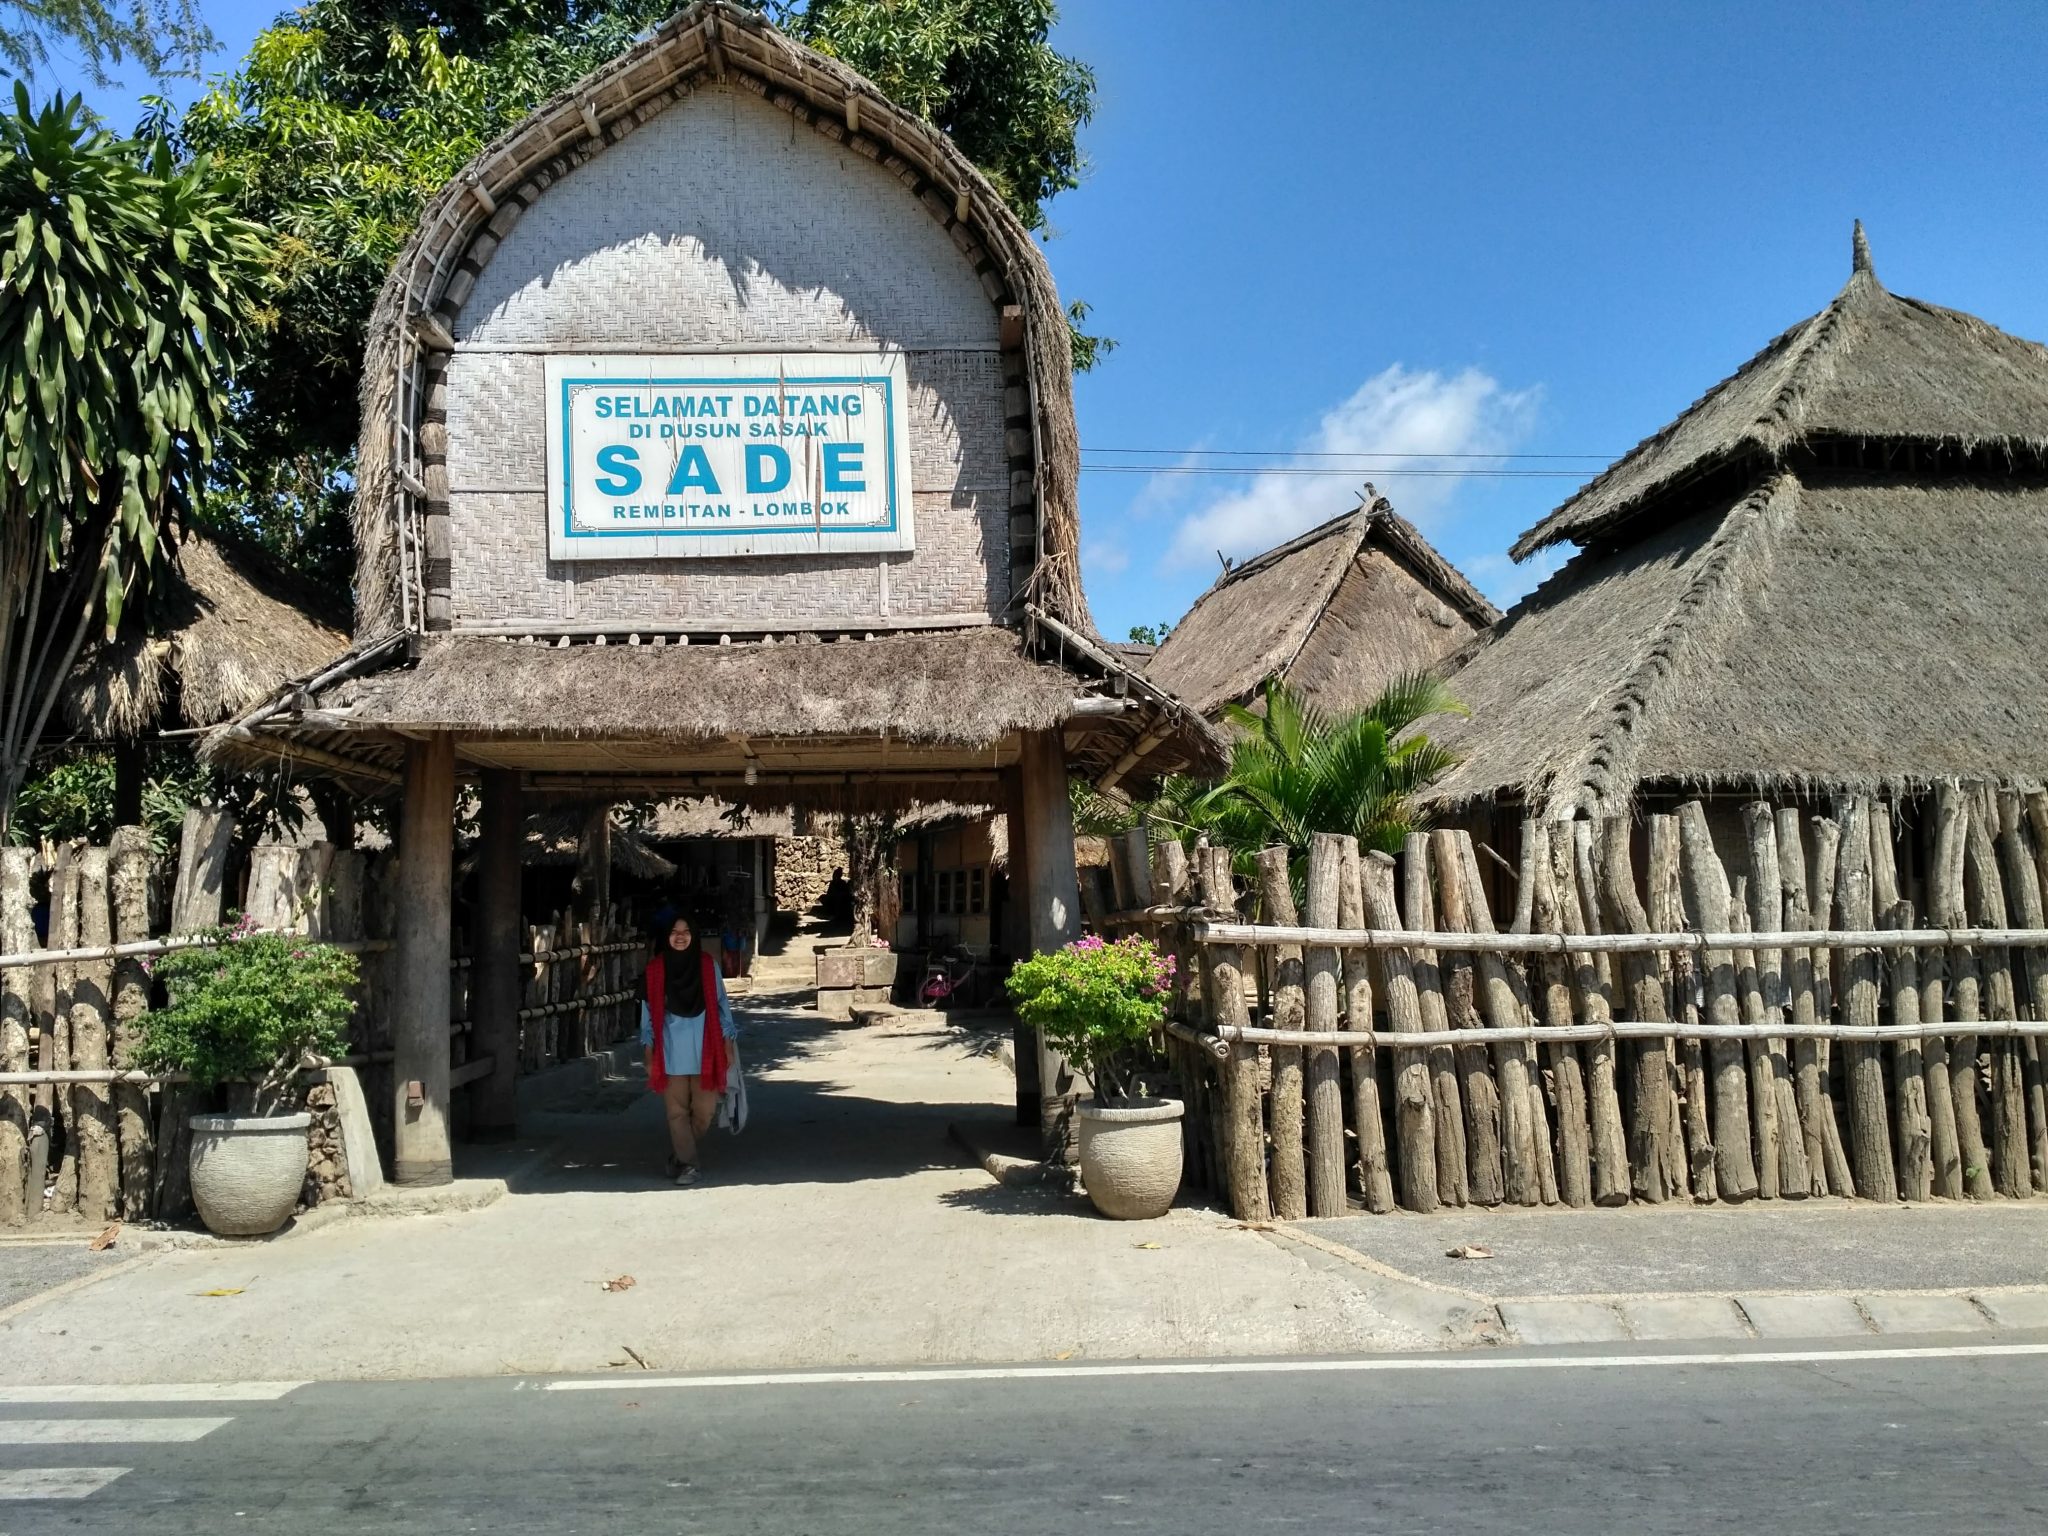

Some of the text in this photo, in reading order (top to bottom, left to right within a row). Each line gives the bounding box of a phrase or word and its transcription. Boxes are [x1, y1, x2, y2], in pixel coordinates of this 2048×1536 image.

[594, 393, 862, 419] SELAMAT DATANG
[629, 421, 828, 439] DI DUSUN SASAK
[594, 442, 867, 497] SADE
[613, 503, 731, 519] REMBITAN
[753, 501, 850, 517] LOMBOK
